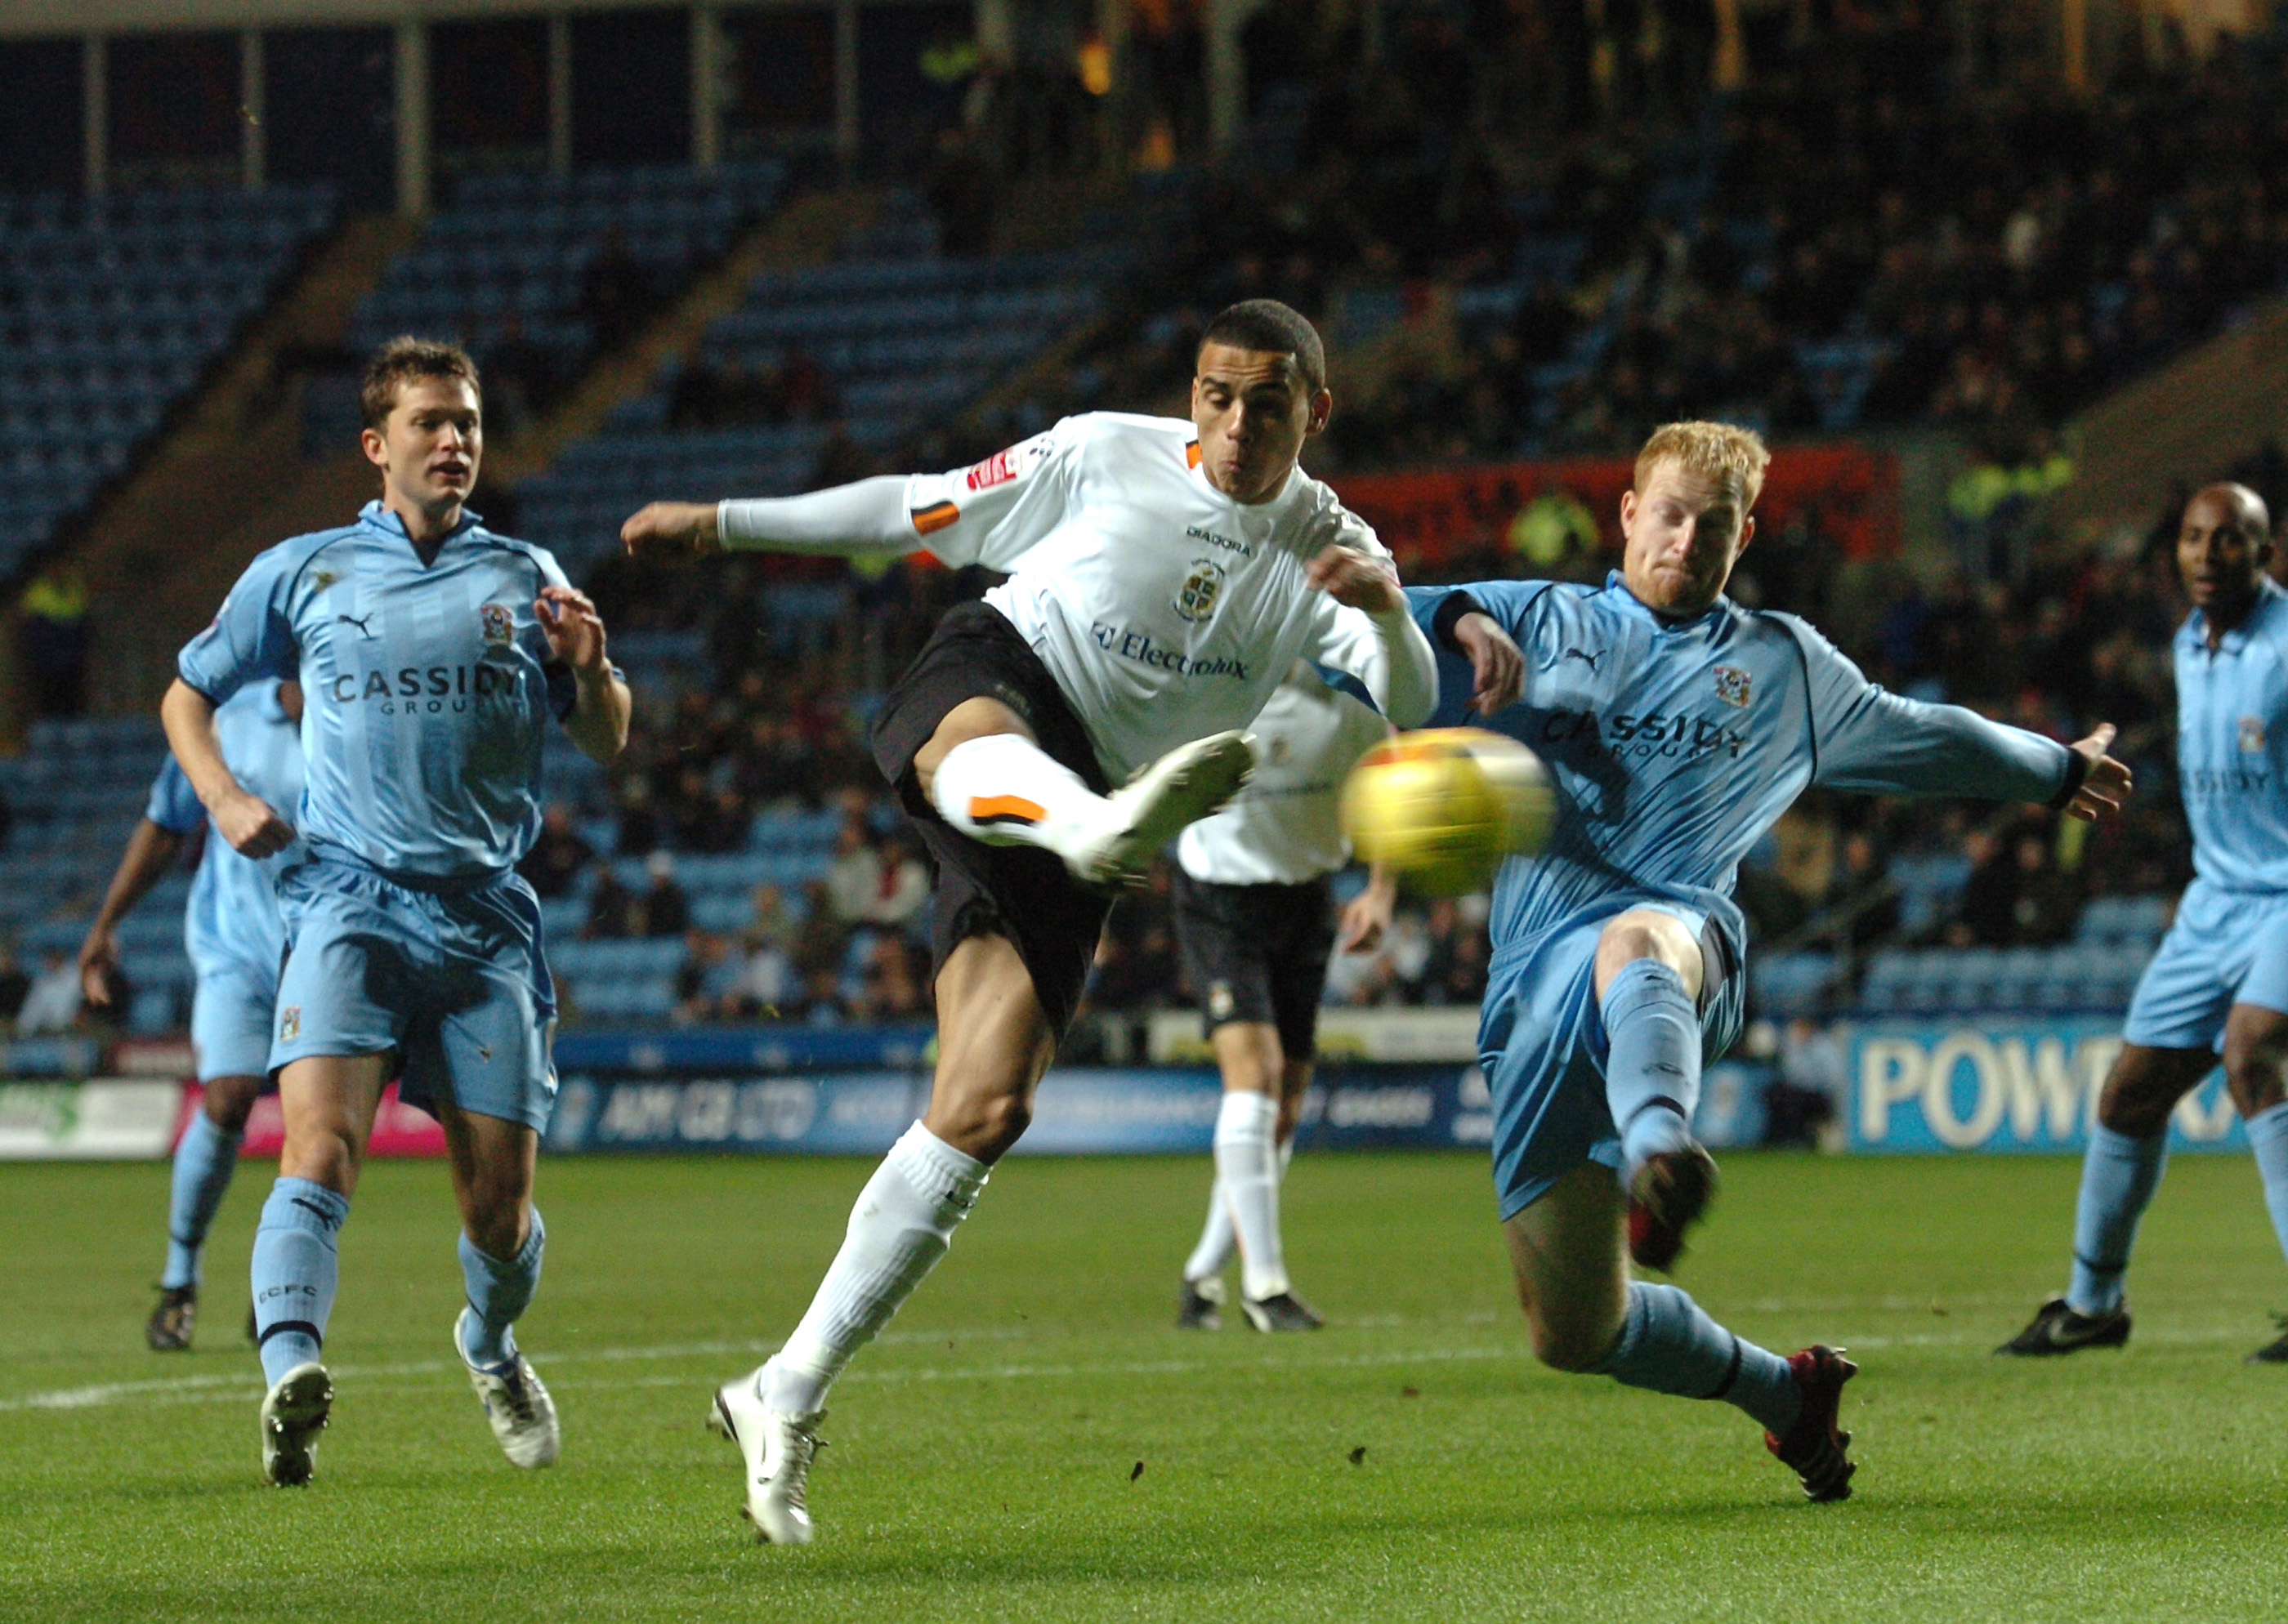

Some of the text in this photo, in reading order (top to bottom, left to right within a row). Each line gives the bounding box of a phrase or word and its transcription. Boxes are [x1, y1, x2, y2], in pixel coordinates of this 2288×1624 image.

[1186, 527, 1252, 558] DIADORA
[1123, 634, 1249, 680] Electrolux
[334, 666, 517, 703] CASSIDY
[1542, 710, 1747, 759] CASSIDY
